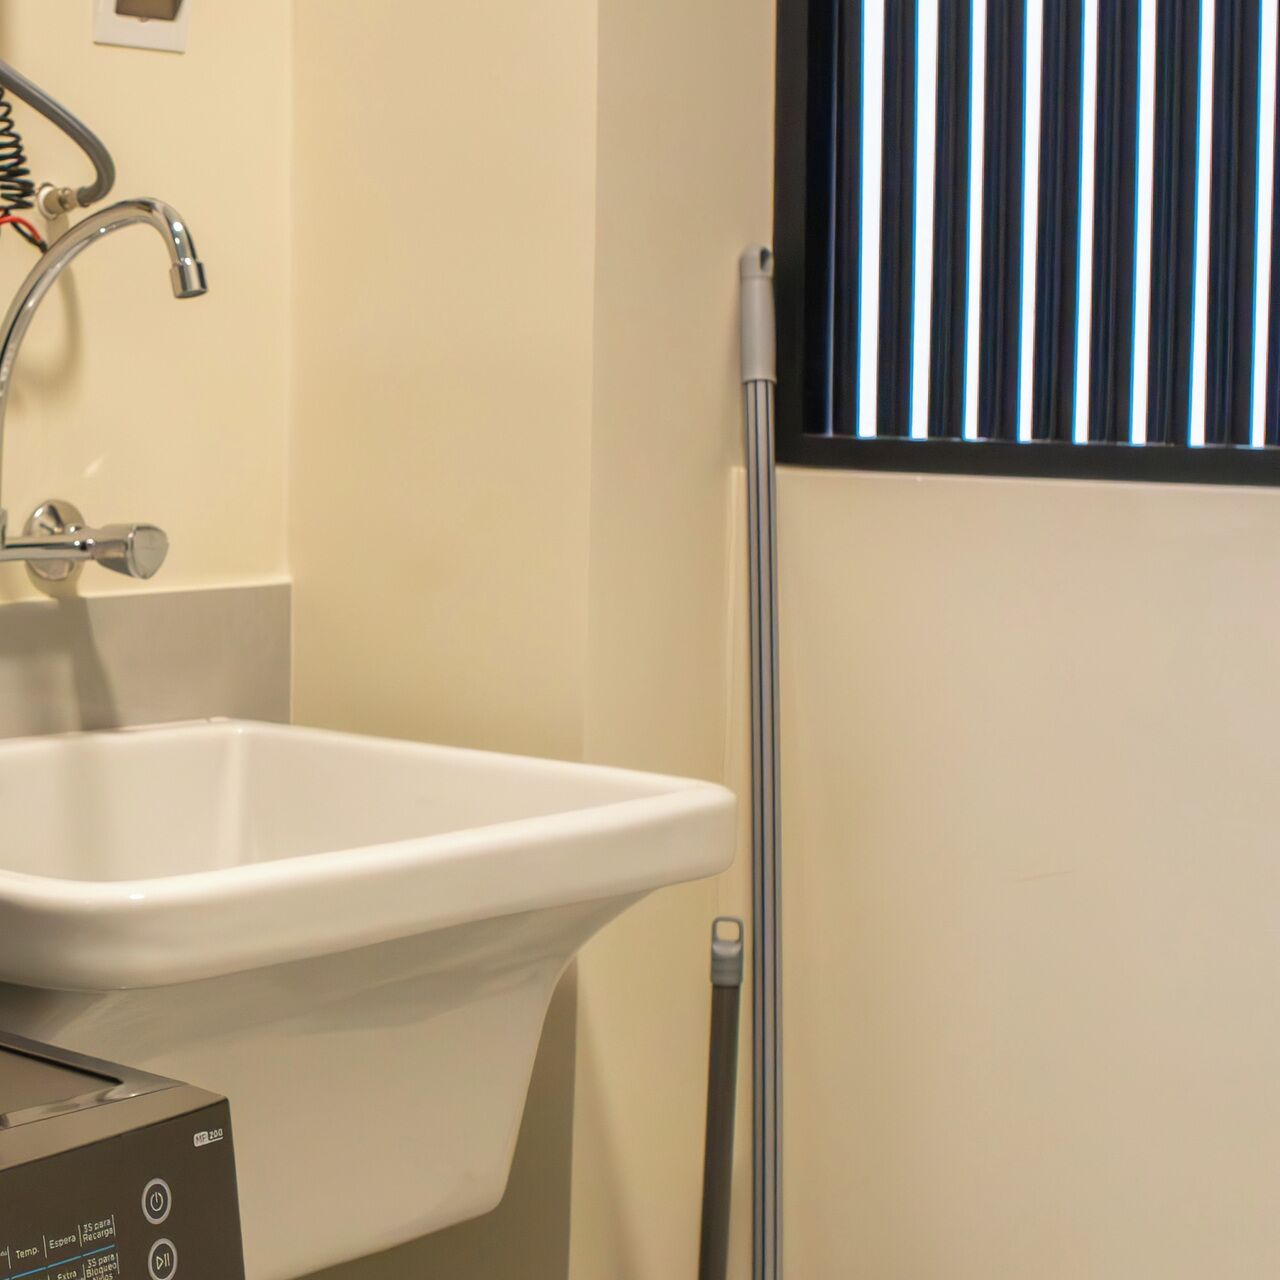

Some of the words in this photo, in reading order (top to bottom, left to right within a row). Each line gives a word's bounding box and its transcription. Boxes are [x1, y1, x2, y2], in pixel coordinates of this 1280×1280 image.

[94, 1219, 112, 1231] para
[49, 1234, 77, 1249] Espera
[82, 1228, 114, 1243] Recarga
[15, 1247, 40, 1260] Temp.
[98, 1254, 115, 1266] para
